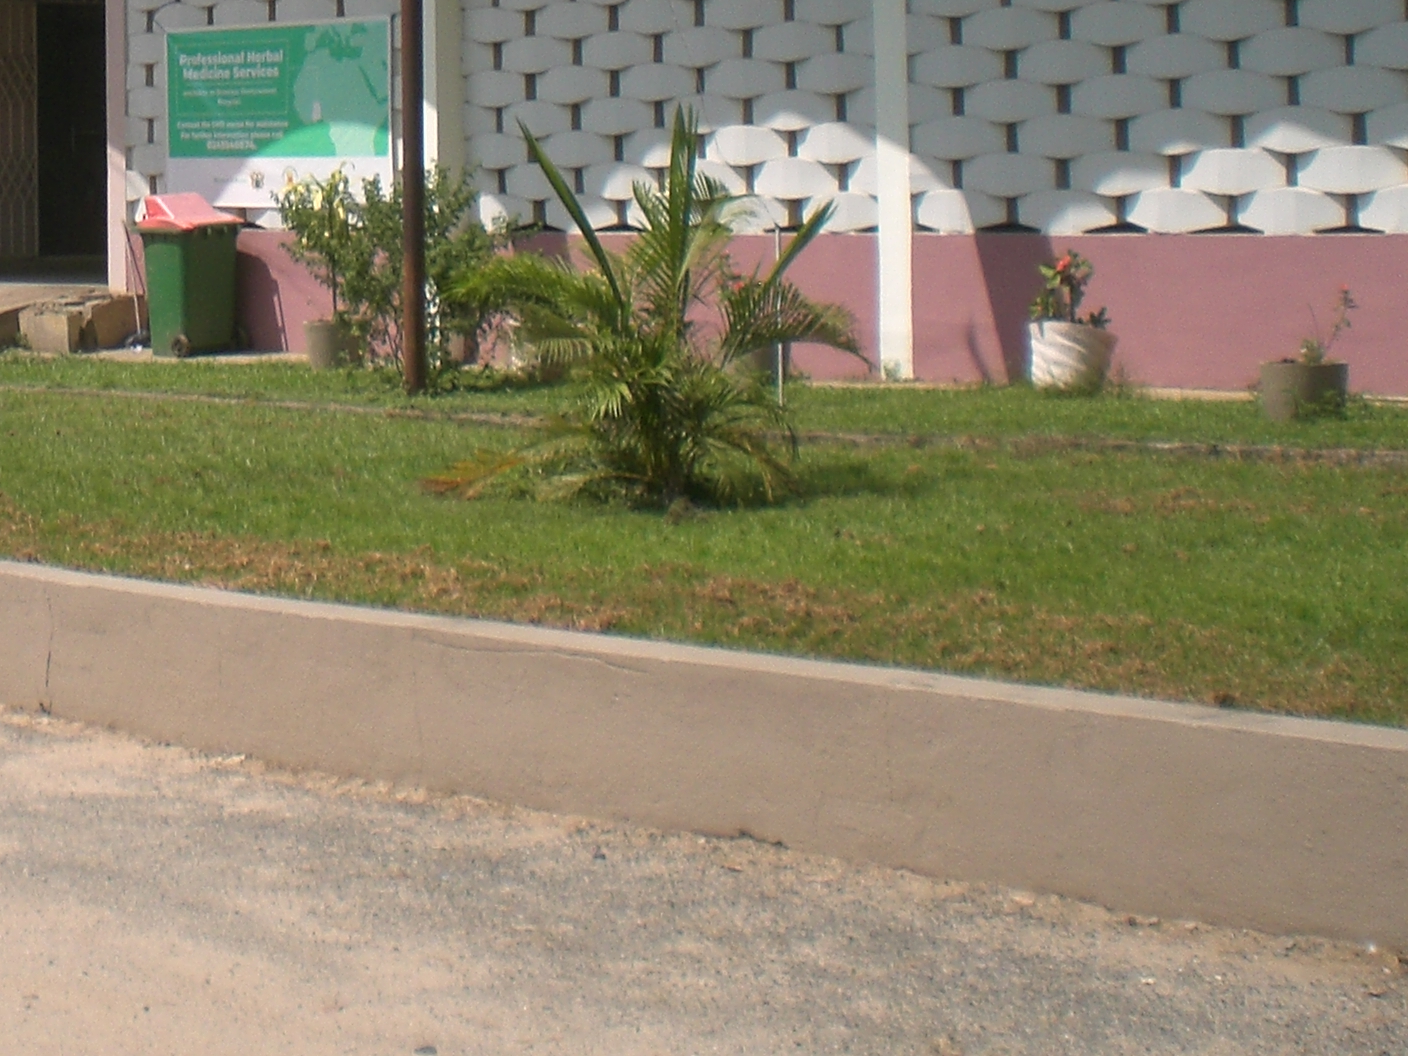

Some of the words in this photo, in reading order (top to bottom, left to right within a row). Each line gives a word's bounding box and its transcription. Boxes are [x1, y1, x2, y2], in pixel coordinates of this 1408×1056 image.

[179, 51, 244, 66] Professional
[246, 49, 284, 63] Herbal
[183, 64, 231, 80] Medicine
[233, 63, 279, 78] Services
